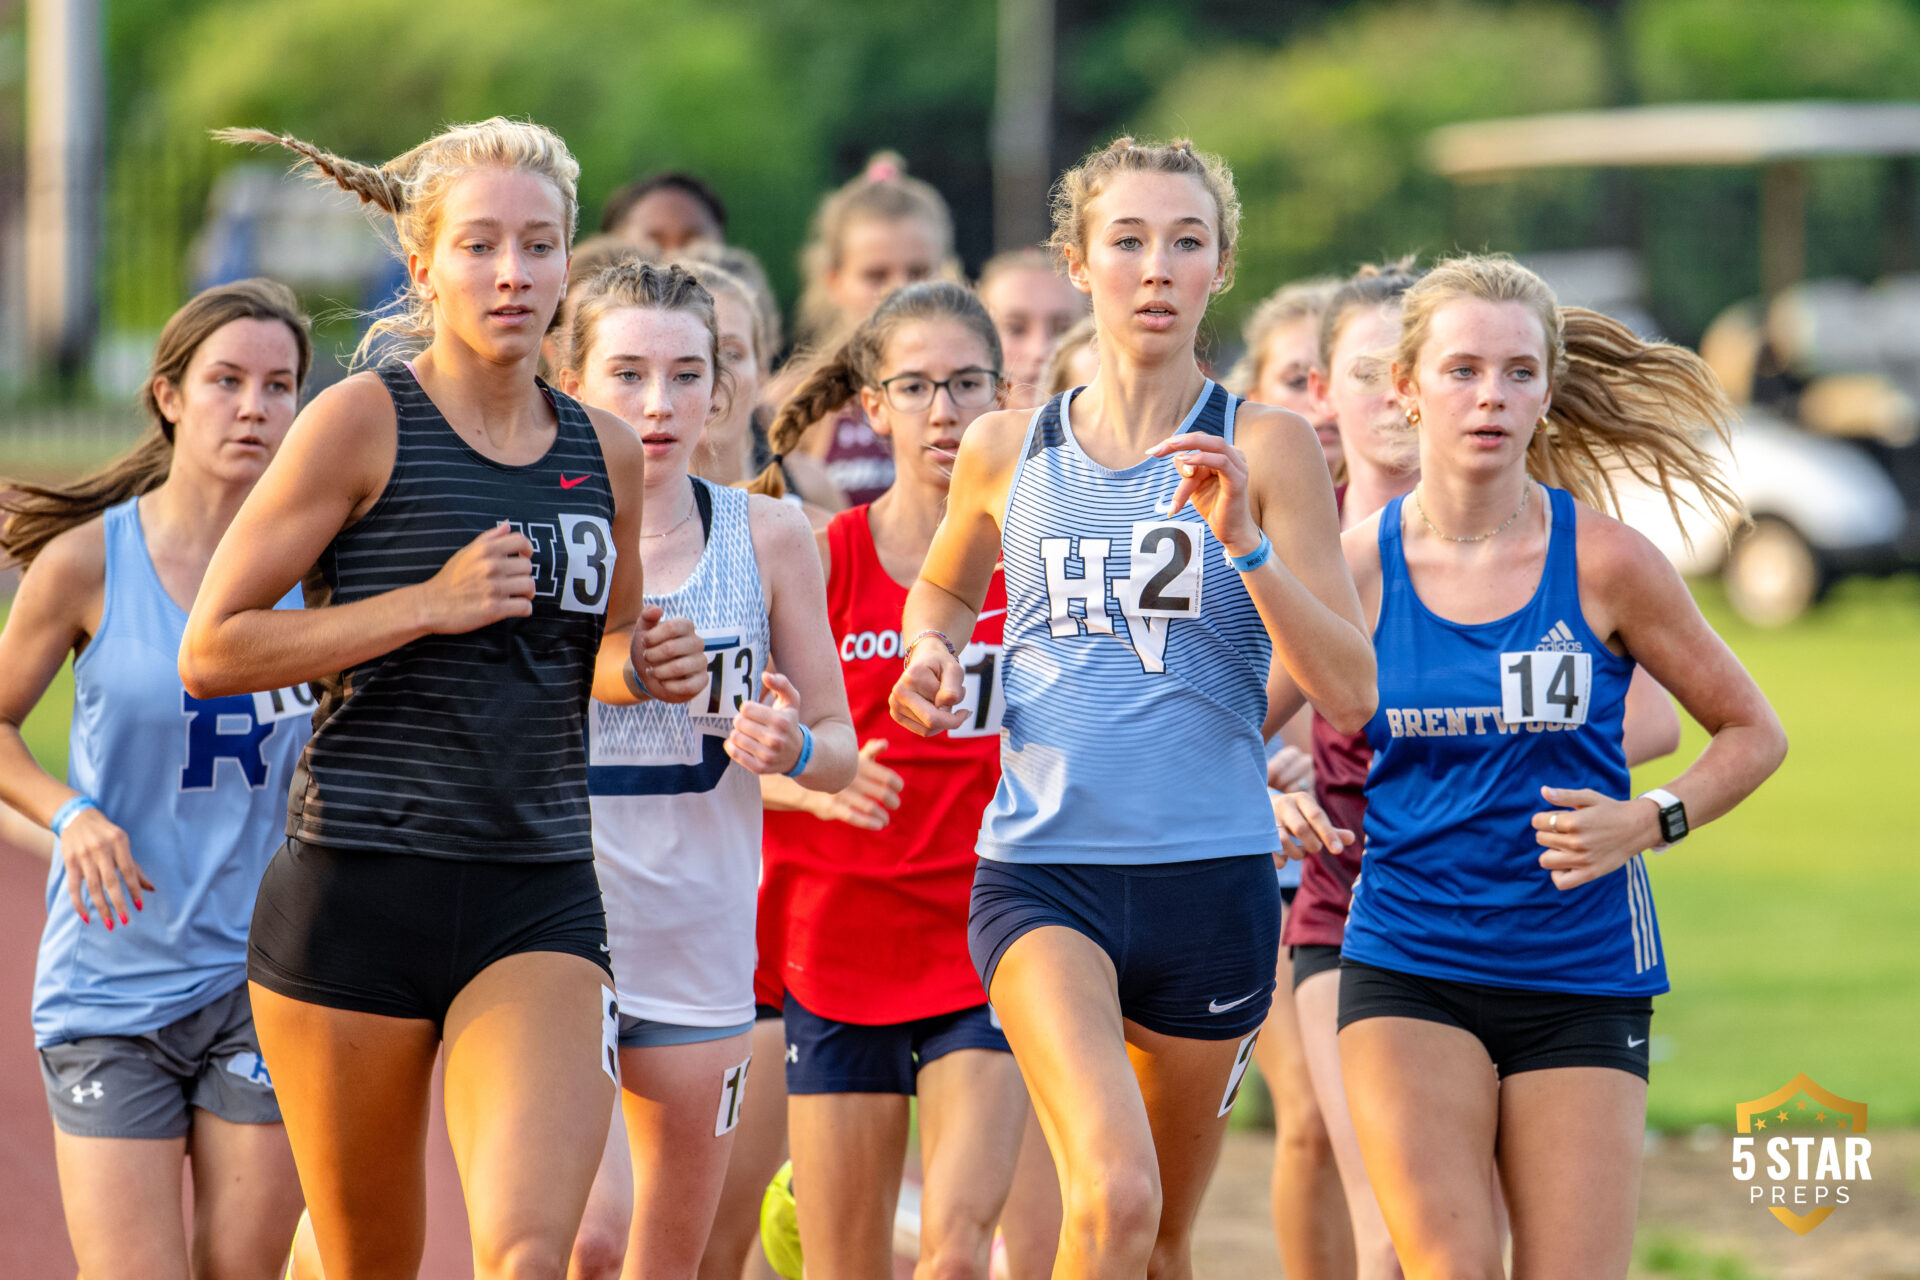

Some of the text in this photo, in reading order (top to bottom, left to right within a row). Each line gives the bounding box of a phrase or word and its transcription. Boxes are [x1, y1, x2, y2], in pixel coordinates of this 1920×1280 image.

[571, 520, 608, 606] 3
[1138, 526, 1193, 611] 2
[1535, 640, 1583, 652] adidas
[706, 647, 753, 714] 13
[1508, 654, 1579, 719] 14
[178, 687, 278, 793] R
[1386, 706, 1578, 738] BRENTW
